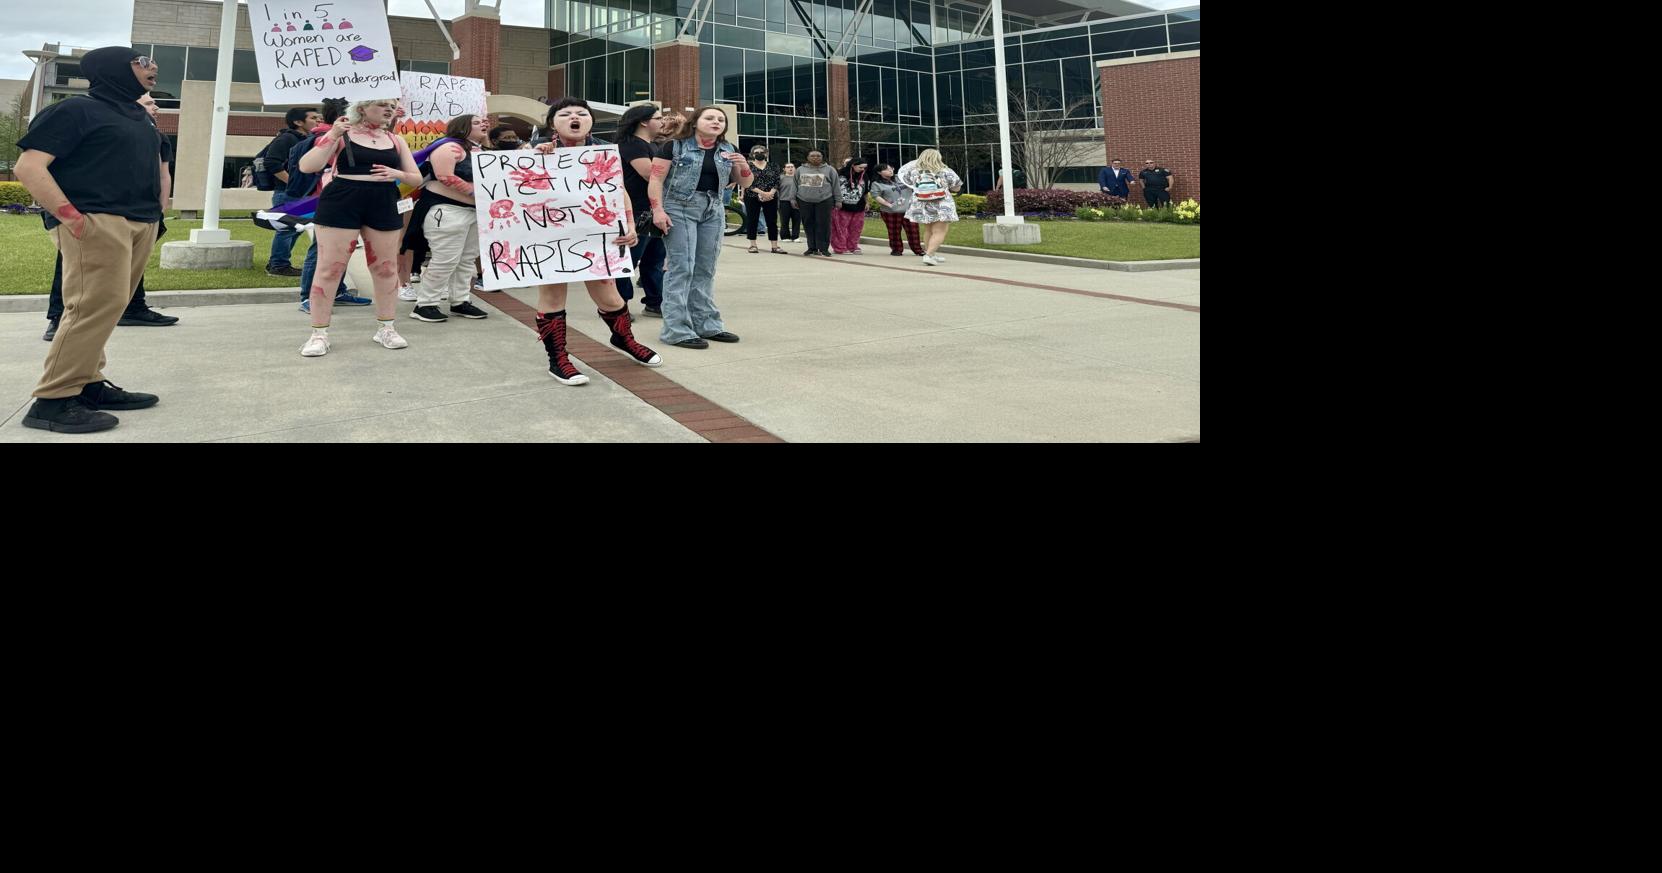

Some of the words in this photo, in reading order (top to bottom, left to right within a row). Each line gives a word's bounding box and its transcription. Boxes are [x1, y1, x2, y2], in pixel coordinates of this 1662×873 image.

[265, 3, 271, 21] 1
[283, 8, 302, 20] in
[313, 3, 334, 19] 5
[263, 31, 325, 48] Women
[335, 33, 362, 43] are
[275, 46, 342, 69] RAPED
[274, 73, 325, 91] during
[333, 71, 396, 88] undergrad
[419, 75, 467, 92] RAPE
[433, 91, 455, 104] IS
[410, 100, 464, 117] BAD
[477, 148, 617, 179] PROTECT
[481, 176, 617, 201] VICTIMS
[522, 205, 582, 231] NOT
